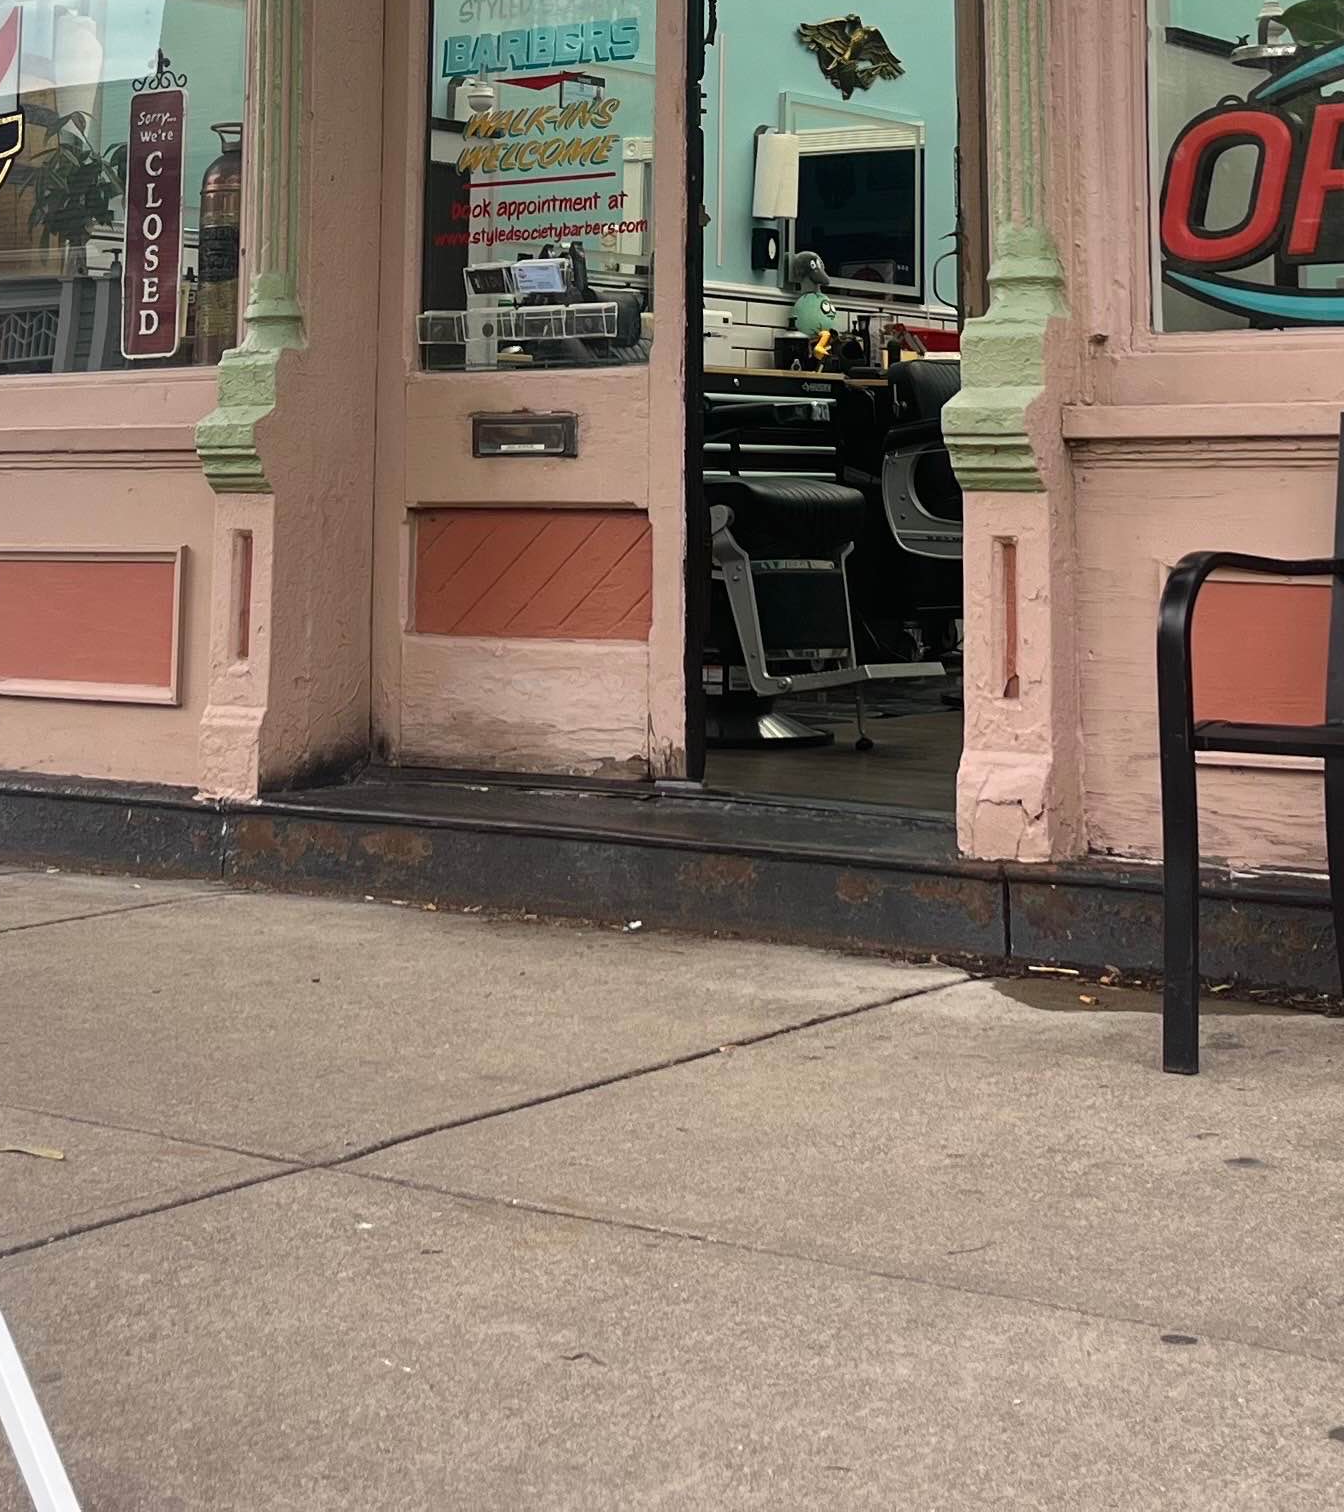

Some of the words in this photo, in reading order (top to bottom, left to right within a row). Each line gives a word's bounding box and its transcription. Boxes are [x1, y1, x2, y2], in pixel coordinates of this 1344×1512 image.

[442, 17, 640, 77] BARBERS
[140, 130, 174, 143] We're
[463, 98, 620, 140] WALK-INS
[457, 135, 620, 175] WELCOME
[451, 196, 491, 220] book
[497, 192, 600, 220] appointment
[608, 191, 629, 209] at
[138, 151, 163, 335] CLOSED
[435, 218, 648, 253] www.styledsocietybarbers.com
